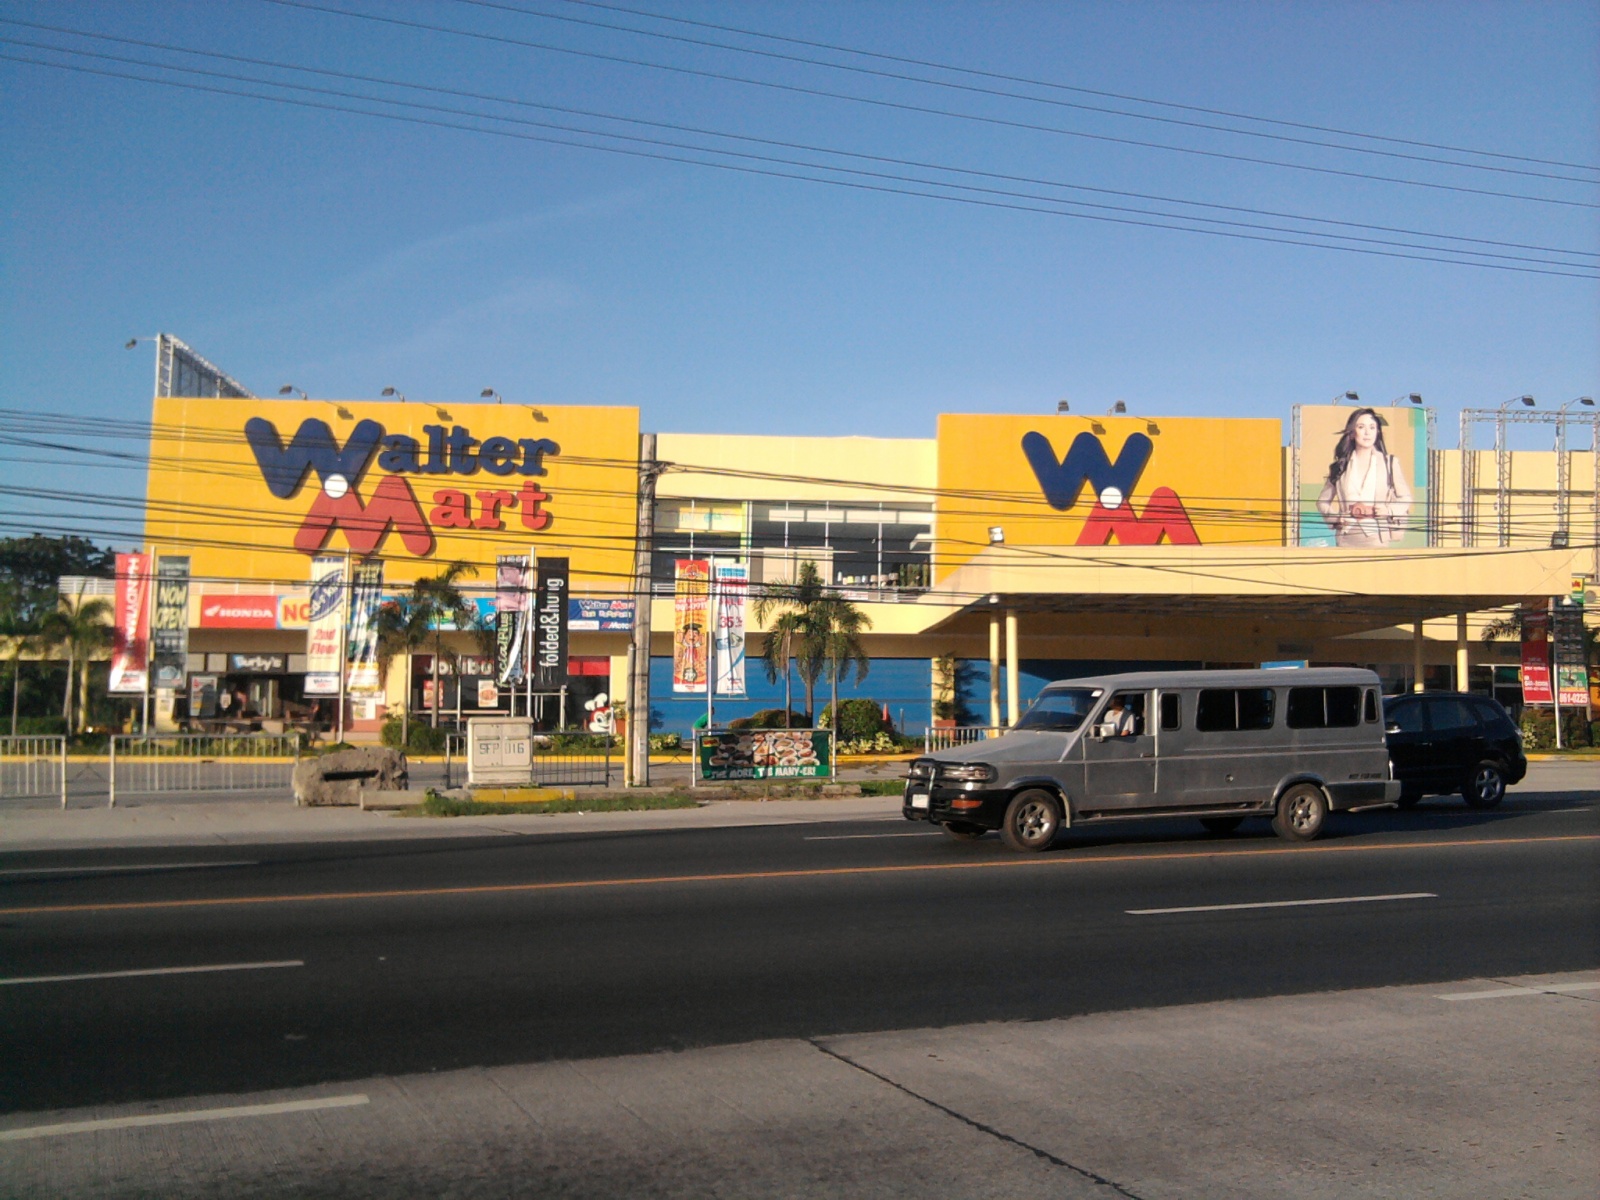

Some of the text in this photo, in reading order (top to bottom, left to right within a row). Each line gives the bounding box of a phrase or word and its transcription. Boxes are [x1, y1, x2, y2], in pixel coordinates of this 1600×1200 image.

[244, 417, 557, 499] Walter
[294, 474, 547, 555] Mart
[160, 586, 187, 605] NOW
[219, 608, 273, 618] HONDA
[310, 643, 338, 655] Floor
[757, 767, 773, 777] TE
